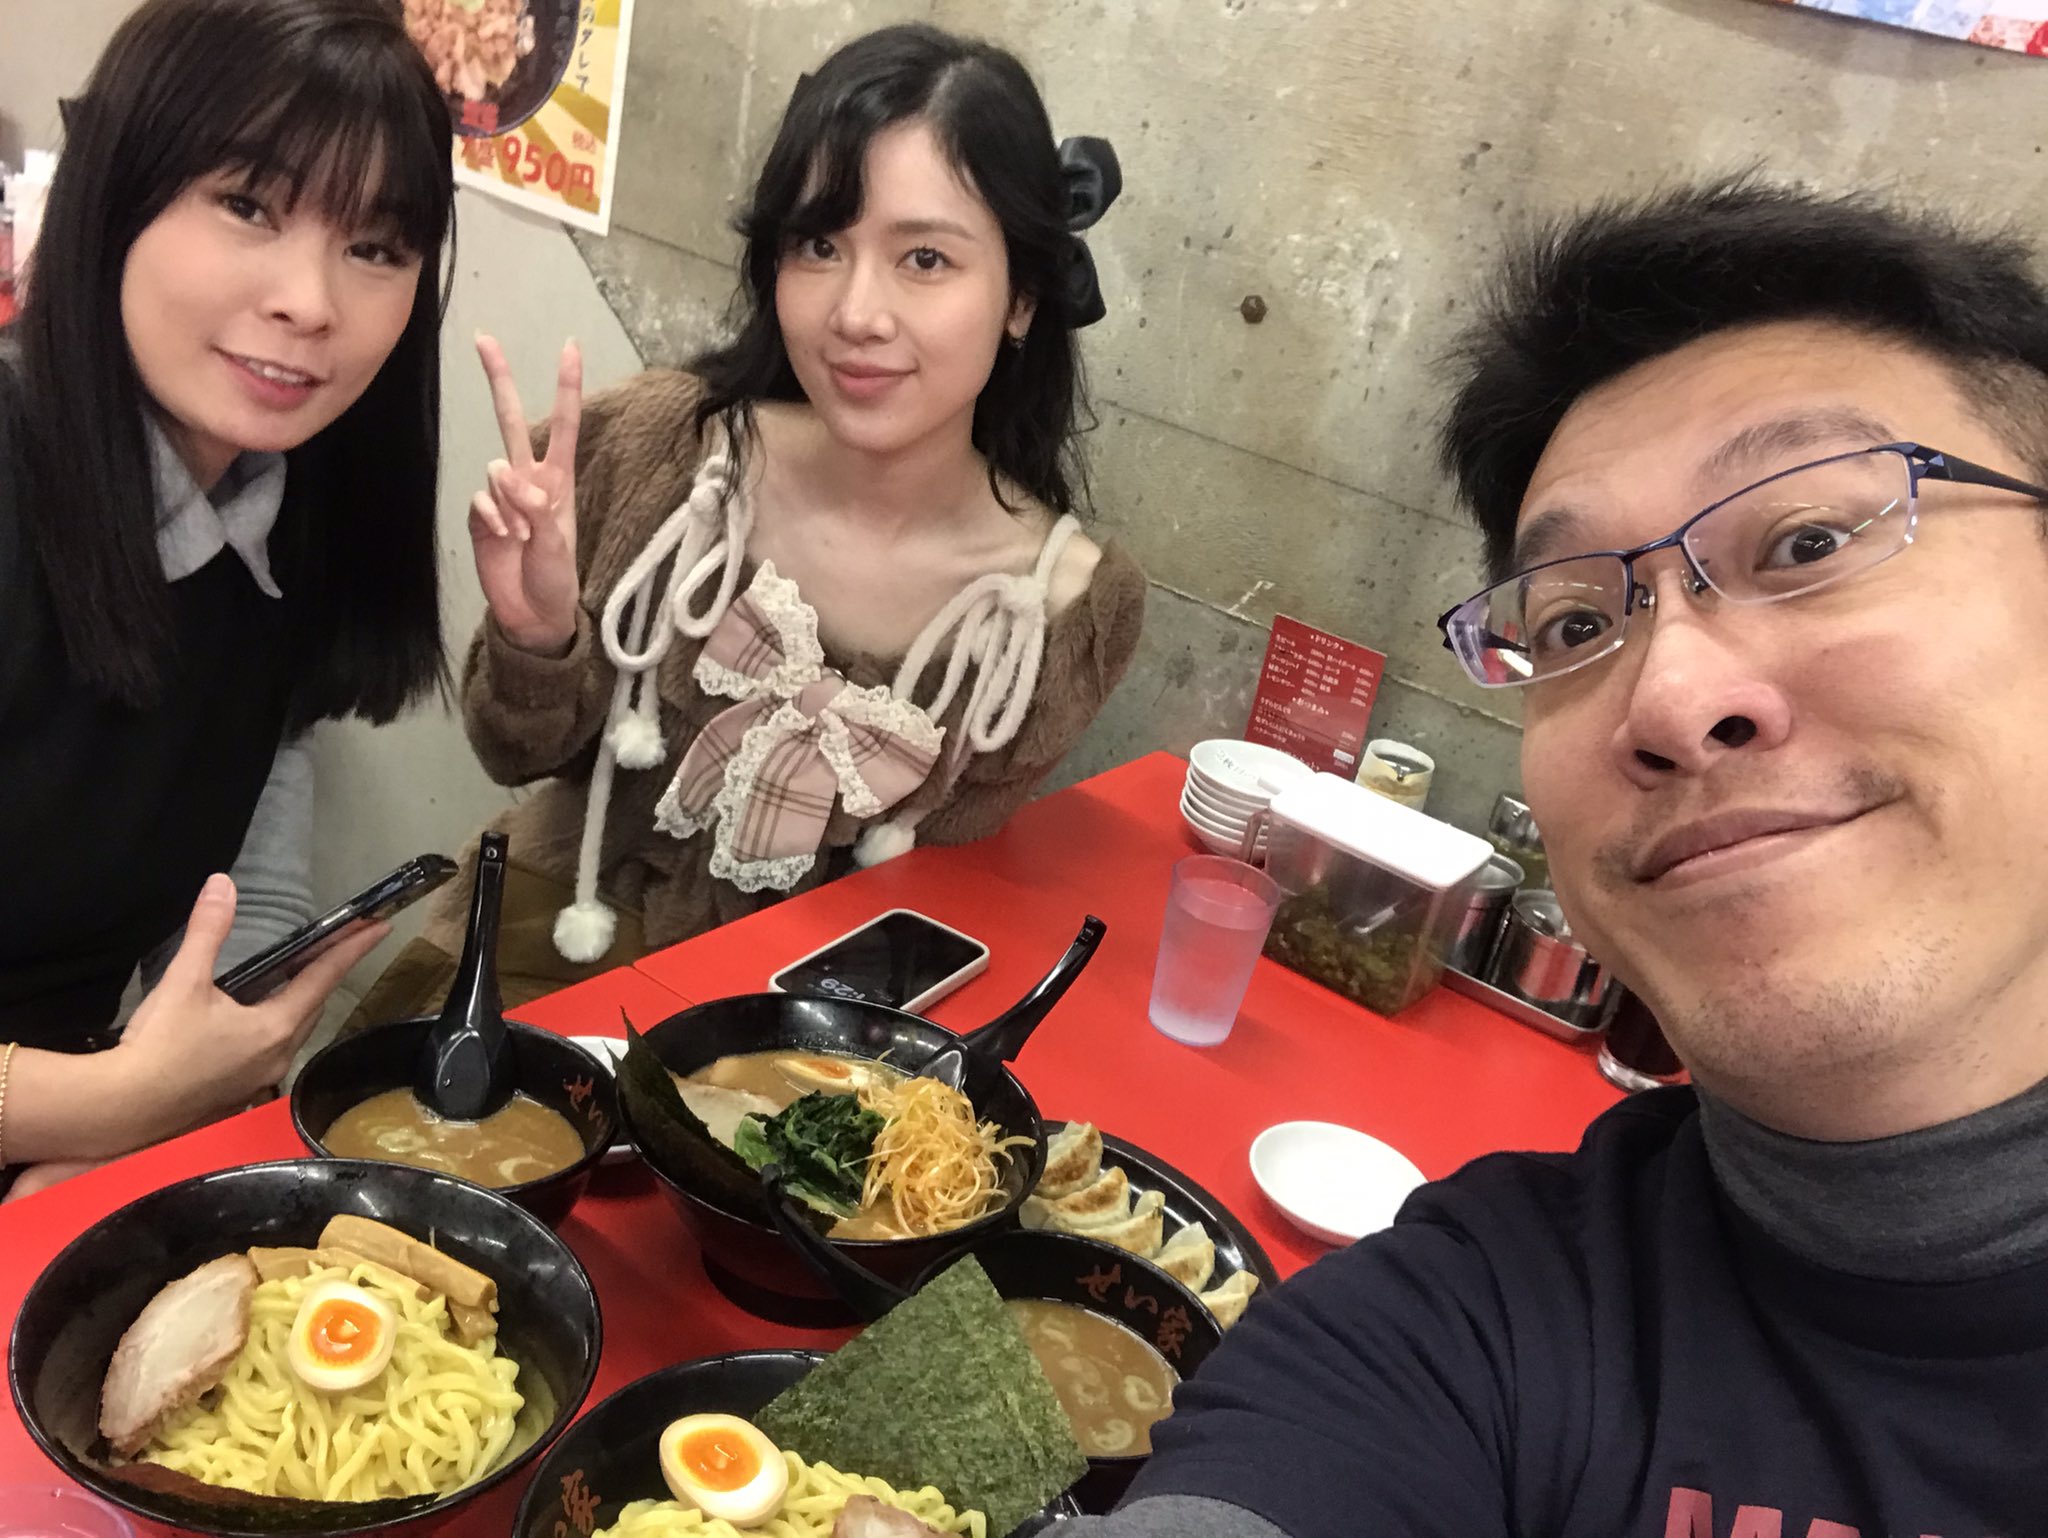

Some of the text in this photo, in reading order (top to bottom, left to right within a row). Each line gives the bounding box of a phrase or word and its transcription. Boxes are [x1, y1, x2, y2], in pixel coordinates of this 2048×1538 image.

[503, 135, 595, 202] 950円
[1075, 1263, 1193, 1360] せい家
